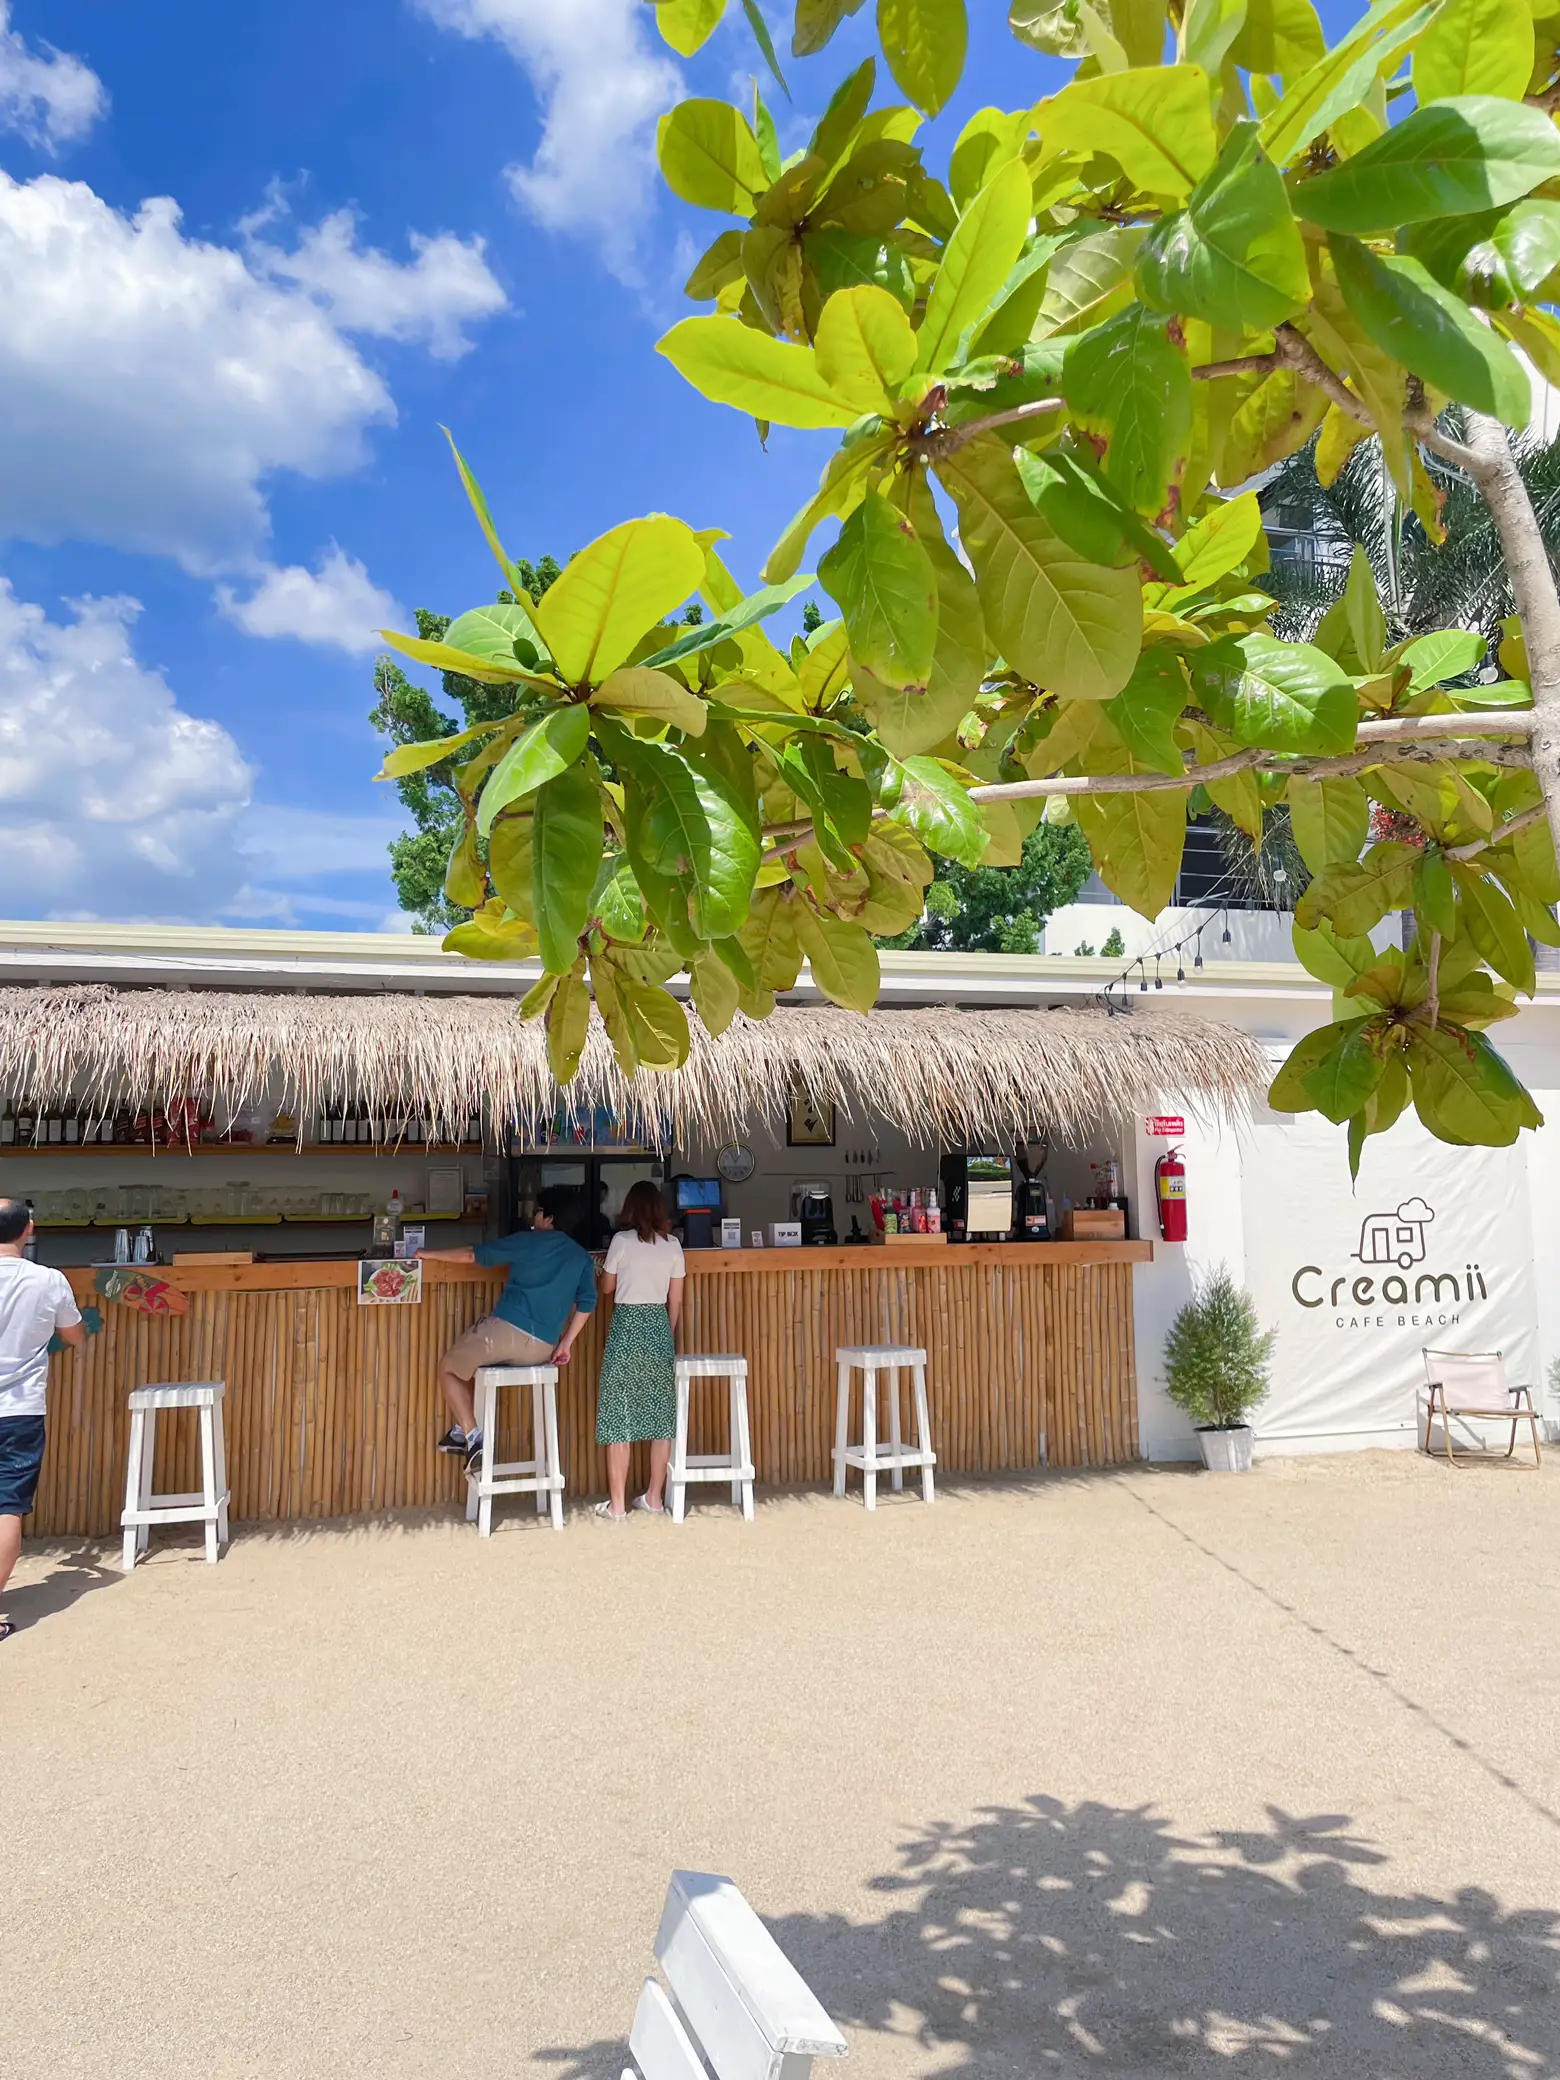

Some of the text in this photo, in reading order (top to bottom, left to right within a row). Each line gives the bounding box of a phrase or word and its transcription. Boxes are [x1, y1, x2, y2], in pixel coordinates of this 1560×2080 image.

[1292, 1264, 1487, 1308] Creamii
[1336, 1314, 1460, 1328] CAFE BEACH
